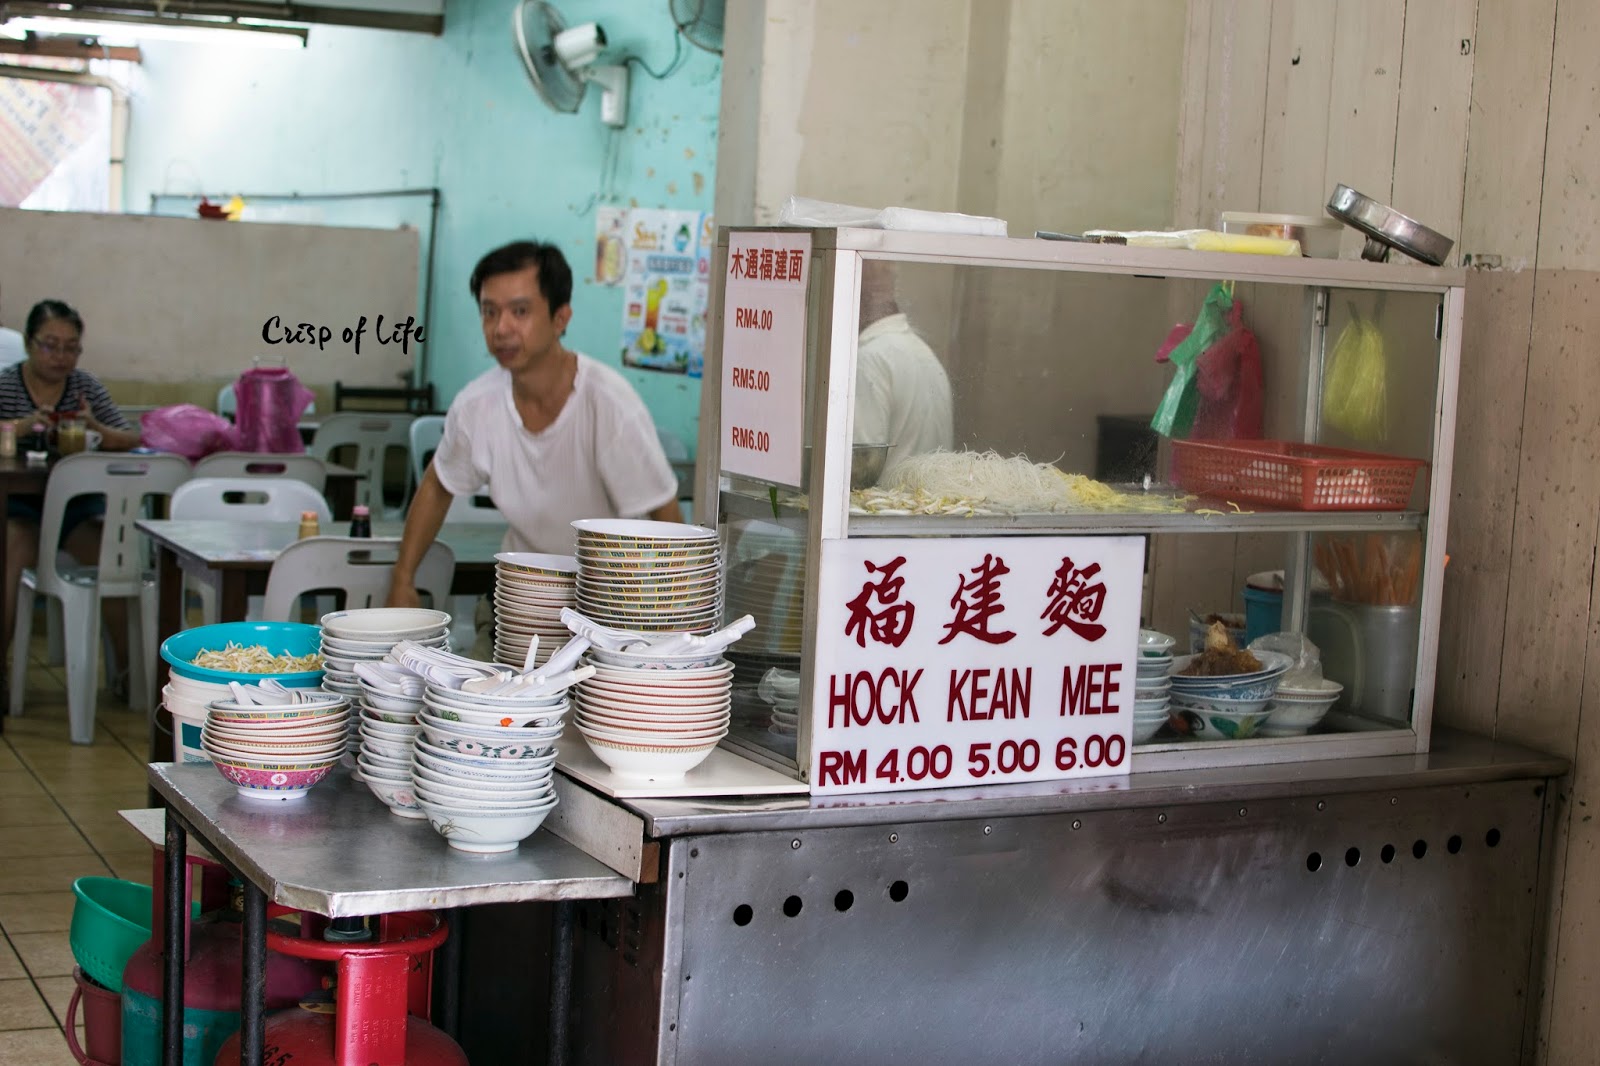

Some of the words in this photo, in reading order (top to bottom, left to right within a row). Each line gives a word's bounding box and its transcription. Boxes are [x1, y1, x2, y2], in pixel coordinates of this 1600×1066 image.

[730, 248, 804, 282] 木通福建面
[736, 307, 773, 331] RM4.00
[732, 367, 770, 392] RM5.00
[732, 426, 770, 452] RM6.00
[828, 667, 924, 728] HOCK
[947, 667, 1032, 722] KEAN
[1060, 663, 1122, 716] MEE
[818, 749, 868, 787] RM
[876, 744, 953, 784] 4.00
[968, 739, 1040, 778] 5.00
[1055, 734, 1126, 770] 6.00
